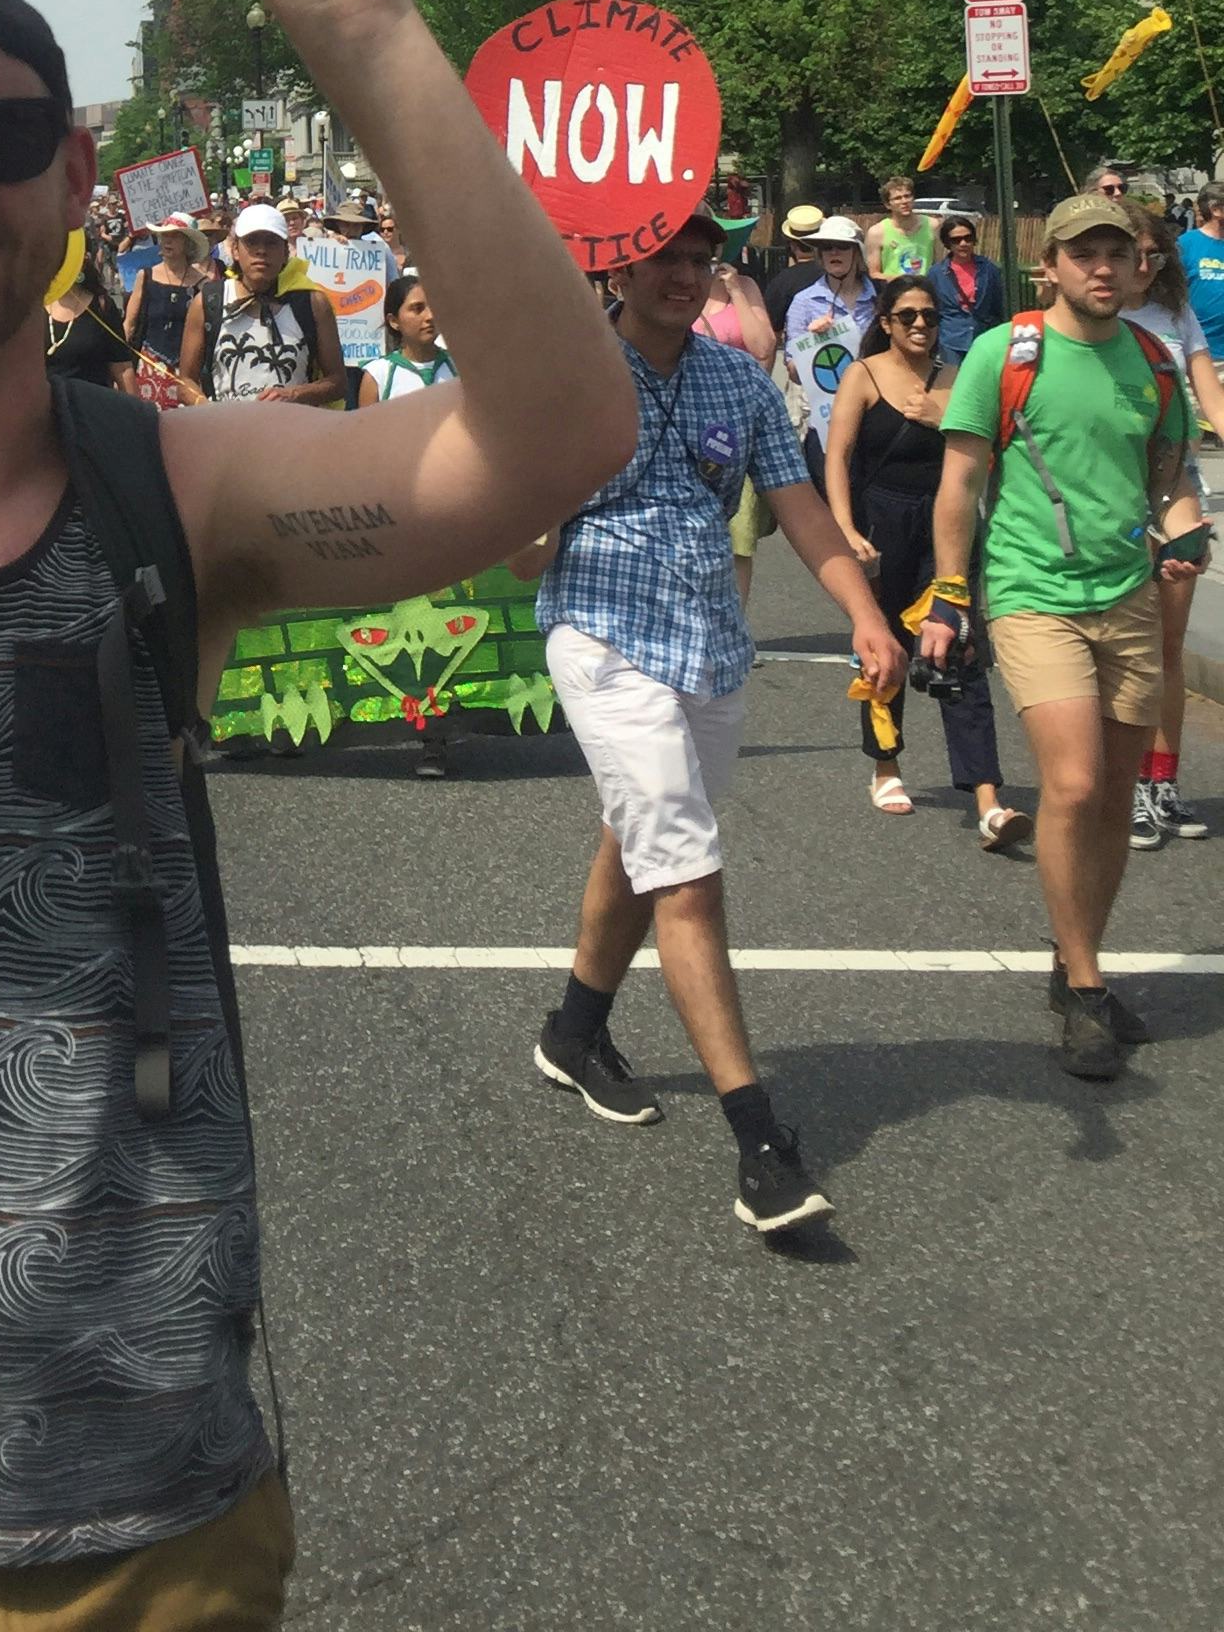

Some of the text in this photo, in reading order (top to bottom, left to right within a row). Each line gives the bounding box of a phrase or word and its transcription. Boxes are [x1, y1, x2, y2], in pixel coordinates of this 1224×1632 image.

[990, 19, 1002, 29] NO
[976, 53, 1019, 63] STANDING
[506, 77, 695, 184] NOW.
[562, 212, 675, 268] TICE
[302, 244, 382, 271] WILL TRADE
